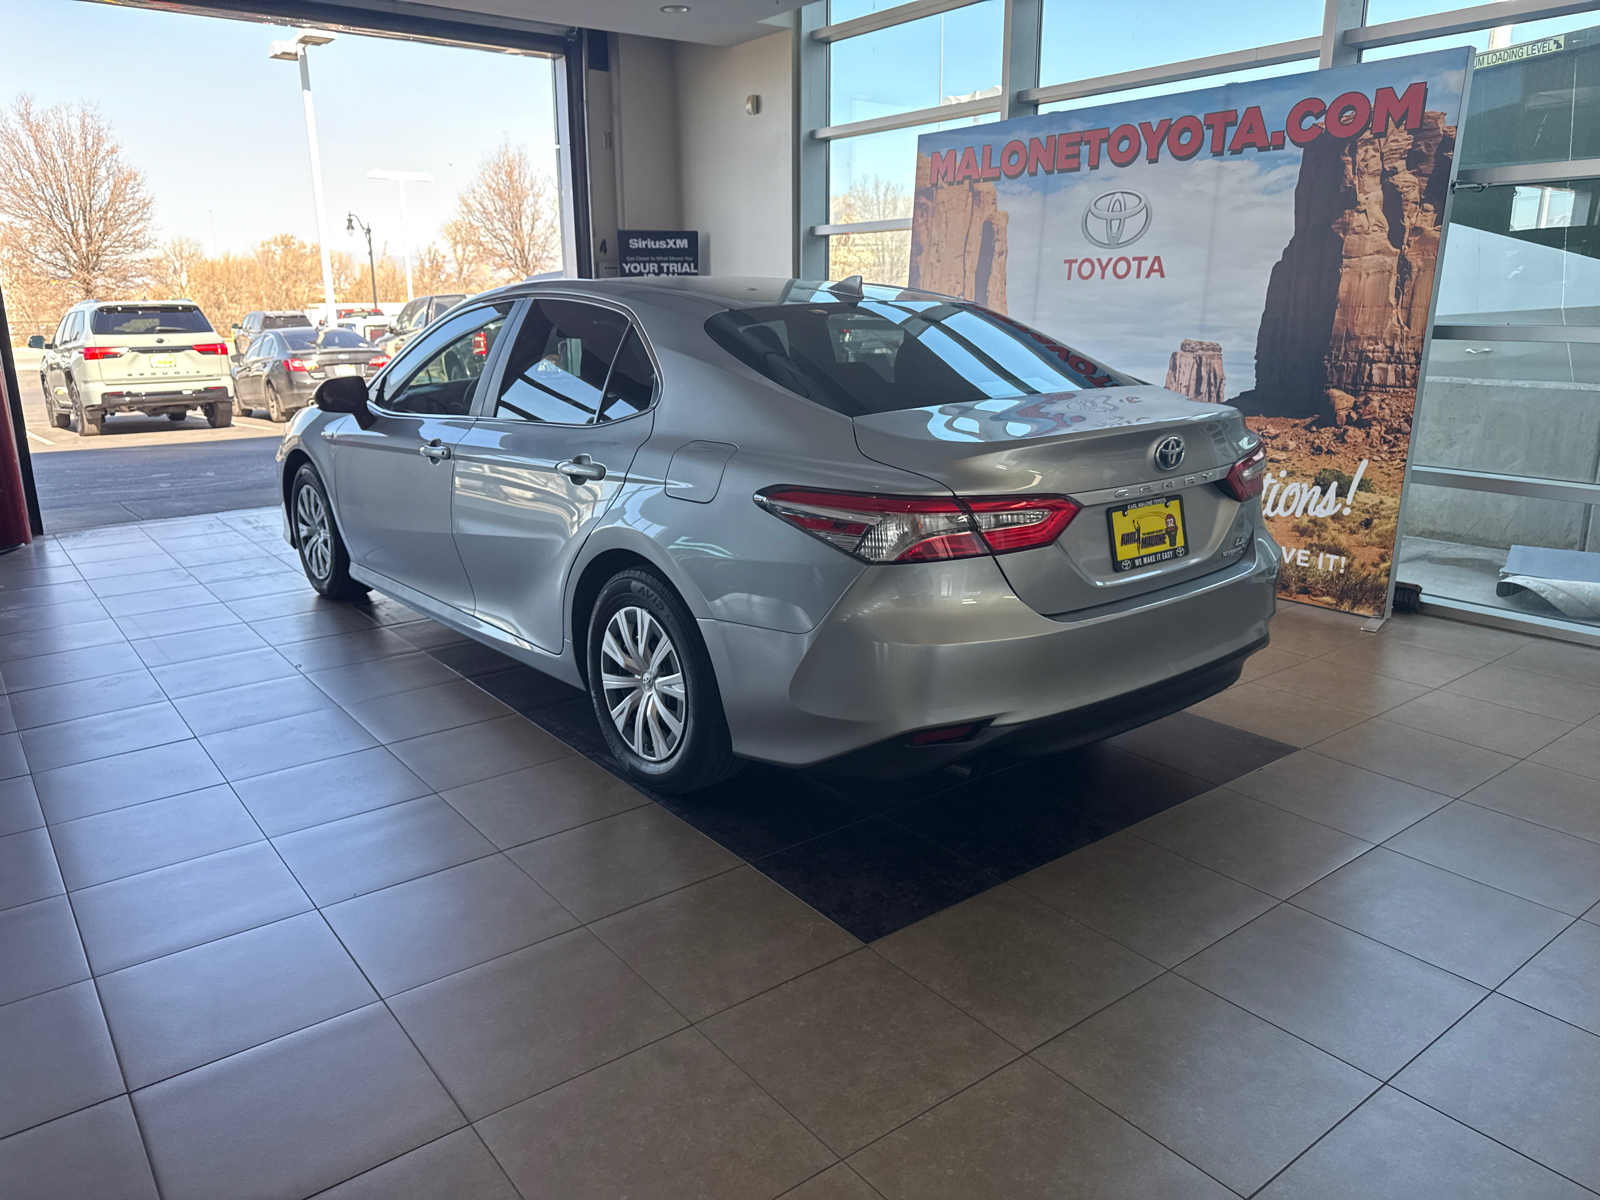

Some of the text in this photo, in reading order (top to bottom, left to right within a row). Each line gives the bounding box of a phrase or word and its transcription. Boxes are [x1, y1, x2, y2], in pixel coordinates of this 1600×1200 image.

[1487, 48, 1524, 65] LOADING
[1526, 42, 1552, 56] LEVEL
[929, 82, 1429, 185] MALONETOYOTA.COM
[600, 238, 608, 255] 4
[628, 238, 688, 249] SiriusXM
[622, 263, 658, 273] YOUR
[660, 262, 698, 273] TRIAL
[1063, 255, 1166, 282] TOYOTA
[1114, 472, 1213, 499] CAMRY
[1128, 502, 1137, 510] KARL
[1138, 500, 1152, 508] MALONE
[1166, 518, 1174, 527] 32
[1121, 533, 1138, 546] KARL
[1143, 556, 1156, 564] MAKE
[1162, 551, 1174, 560] EASY
[1318, 552, 1346, 574] IT!
[637, 586, 665, 612] AVID
